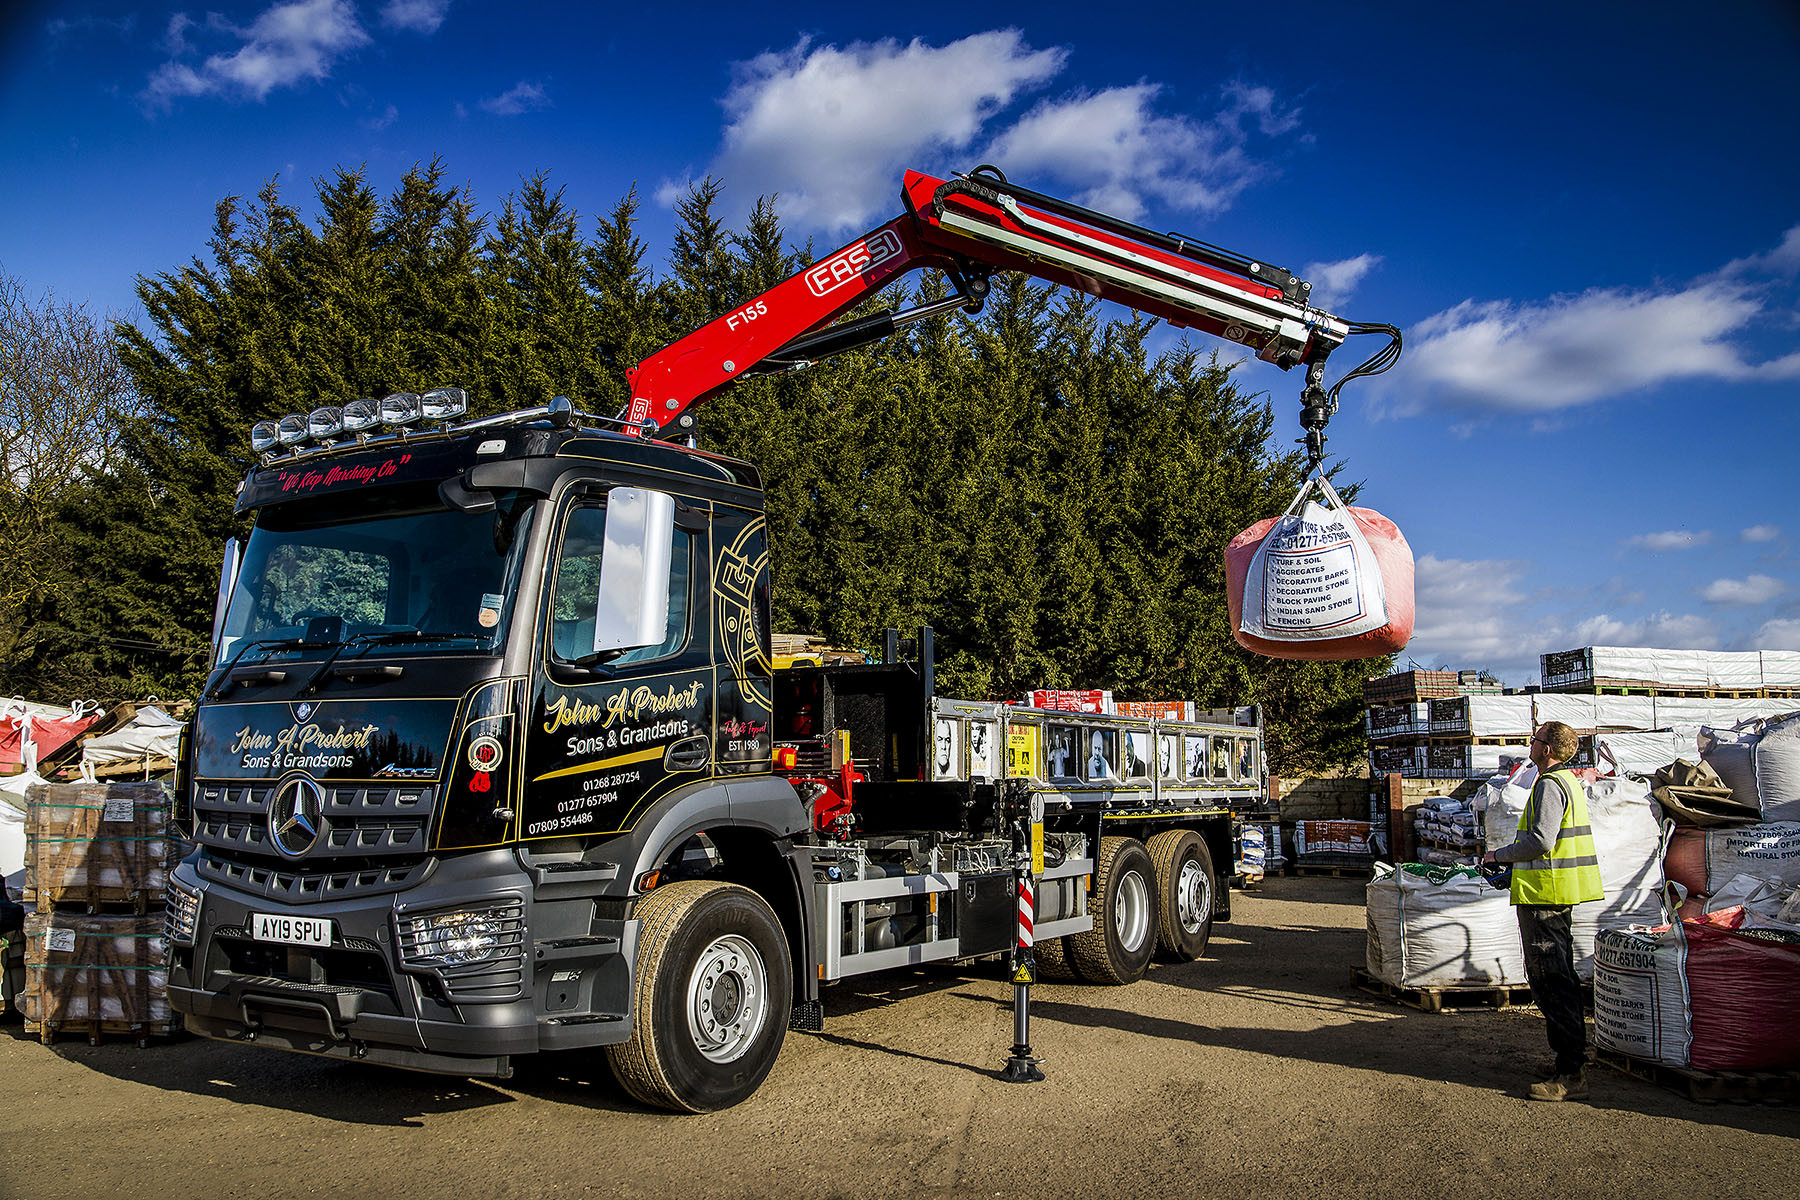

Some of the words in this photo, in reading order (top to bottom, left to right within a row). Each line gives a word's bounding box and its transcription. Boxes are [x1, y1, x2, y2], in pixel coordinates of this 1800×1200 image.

[811, 235, 896, 292] FASSI
[726, 300, 768, 332] F155
[298, 469, 323, 492] Keep
[323, 465, 377, 485] Marching
[1276, 559, 1294, 567] TURF
[1295, 558, 1302, 566] &
[1304, 556, 1322, 565] SOIL
[1276, 565, 1326, 576] AGGREGATES
[1276, 575, 1323, 586] DECORATIVE
[1324, 568, 1350, 582] BARKS
[1276, 586, 1323, 596] DECORATIVE
[1325, 578, 1350, 591] STONE
[1276, 597, 1302, 606] BLOCK
[1303, 593, 1332, 605] PAVING
[1276, 607, 1303, 616] INDIAN
[1304, 604, 1327, 615] SAND
[1327, 596, 1354, 611] STONE
[1277, 617, 1312, 626] FENCING
[544, 694, 602, 735] John
[230, 725, 273, 755] John
[566, 735, 605, 757] Sons
[606, 729, 618, 749] &
[618, 719, 690, 747] Grandsons
[728, 740, 742, 752] EST
[744, 739, 760, 751] 1980
[242, 753, 271, 769] Sons
[271, 752, 282, 768] &
[283, 751, 355, 768] Grandsons
[583, 777, 610, 792] 01268
[611, 770, 641, 787] 287254
[557, 797, 586, 813] 01277
[586, 791, 618, 807] 657904
[528, 819, 559, 835] 07809
[560, 811, 593, 828] 554486
[1727, 837, 1779, 850] IMPORTERS
[1780, 841, 1791, 849] OF
[1737, 850, 1780, 860] NATURAL
[262, 918, 291, 939] AY19
[294, 921, 322, 942] SPU
